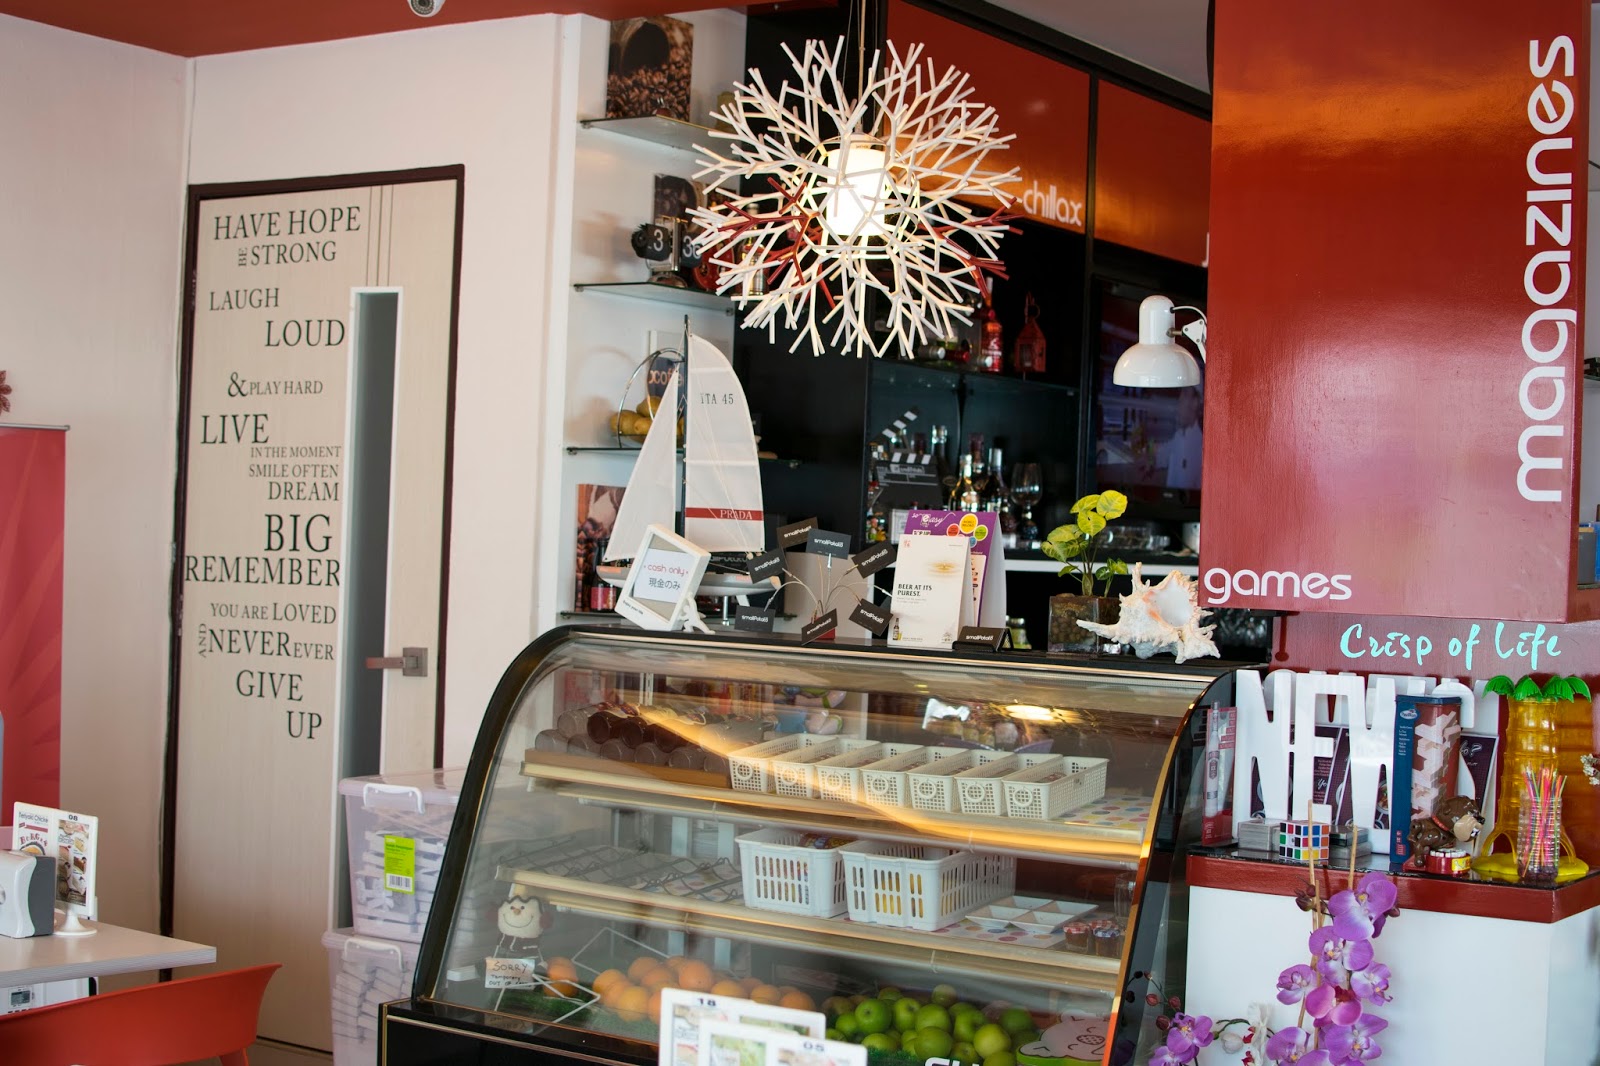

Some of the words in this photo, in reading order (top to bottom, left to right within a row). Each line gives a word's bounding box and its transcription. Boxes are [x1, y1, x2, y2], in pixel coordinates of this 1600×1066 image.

[1023, 180, 1082, 227] chillax
[214, 212, 281, 240] HAVE
[288, 206, 361, 235] HOPE
[238, 248, 247, 267] BE
[251, 241, 337, 266] STRONG
[1516, 35, 1577, 501] magazines
[209, 287, 280, 311] LAUGH
[265, 319, 345, 347] LOUD
[228, 371, 249, 397] &
[249, 381, 281, 396] PLAY
[283, 380, 323, 395] HARD
[722, 393, 734, 405] 45
[201, 413, 269, 444] LIVE
[250, 447, 262, 459] IN
[263, 446, 288, 459] THE
[289, 446, 342, 458] MOMENT
[249, 464, 289, 478] SMILE
[292, 464, 339, 478] OFTEN
[268, 481, 340, 501] DREAM
[720, 509, 753, 520] PRADA
[264, 513, 333, 552] BIG
[185, 555, 341, 587] REMEMBER
[647, 563, 667, 573] cash
[668, 566, 685, 577] only
[648, 577, 681, 590] 現金のみ
[1203, 567, 1352, 604] games
[210, 602, 239, 618] YOU
[242, 605, 269, 620] ARE
[272, 602, 337, 624] LOVED
[199, 623, 207, 659] AND
[208, 628, 291, 657] NEVER
[293, 642, 335, 661] EVER
[1340, 623, 1432, 666] Crisp
[1448, 623, 1481, 671] of
[236, 669, 304, 702] GIVE
[286, 710, 322, 740] UP
[492, 961, 528, 974] SORRY
